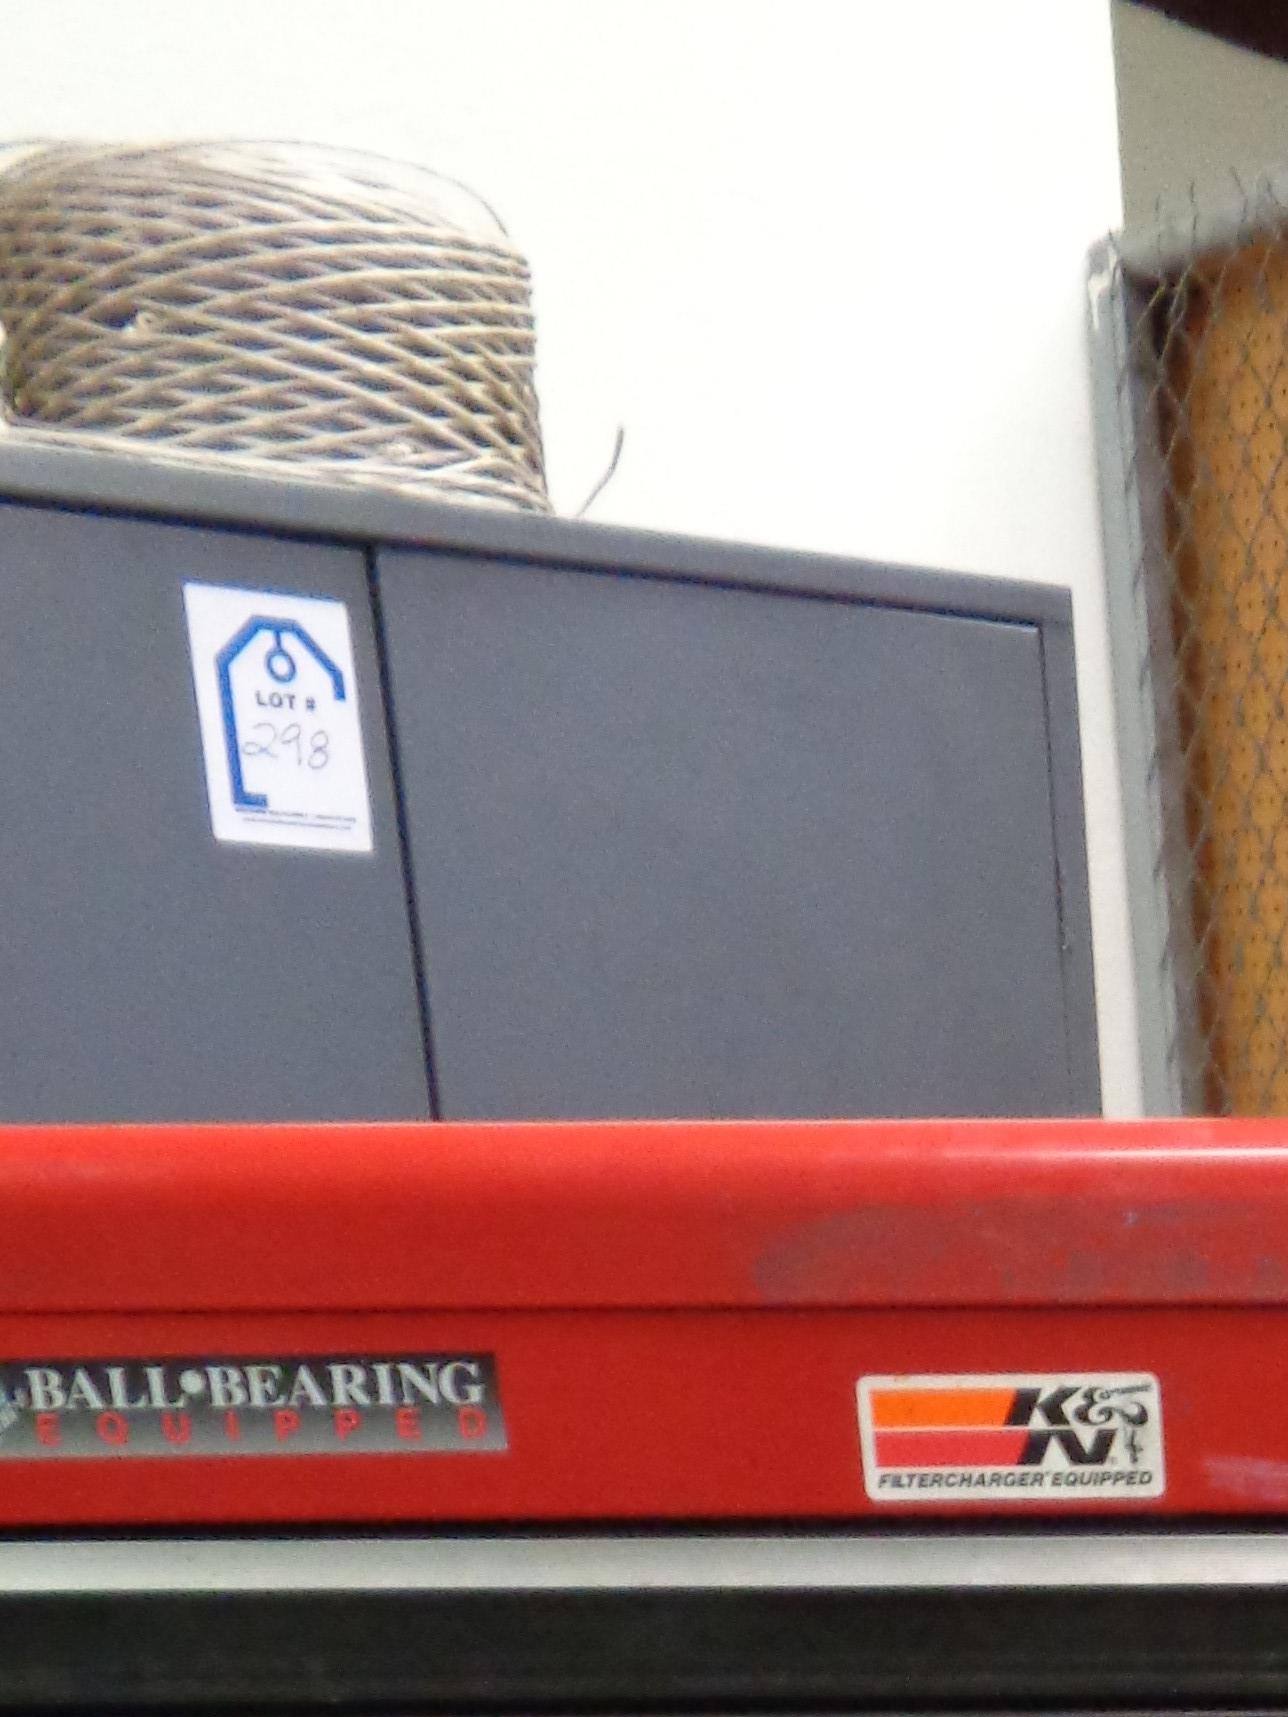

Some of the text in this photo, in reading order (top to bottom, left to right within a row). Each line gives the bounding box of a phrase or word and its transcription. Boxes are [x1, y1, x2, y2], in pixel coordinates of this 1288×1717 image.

[255, 690, 296, 710] LOT
[243, 722, 328, 770] 298
[36, 1407, 488, 1448] EQUIPPED
[1051, 1470, 1152, 1487] EQUIPPED
